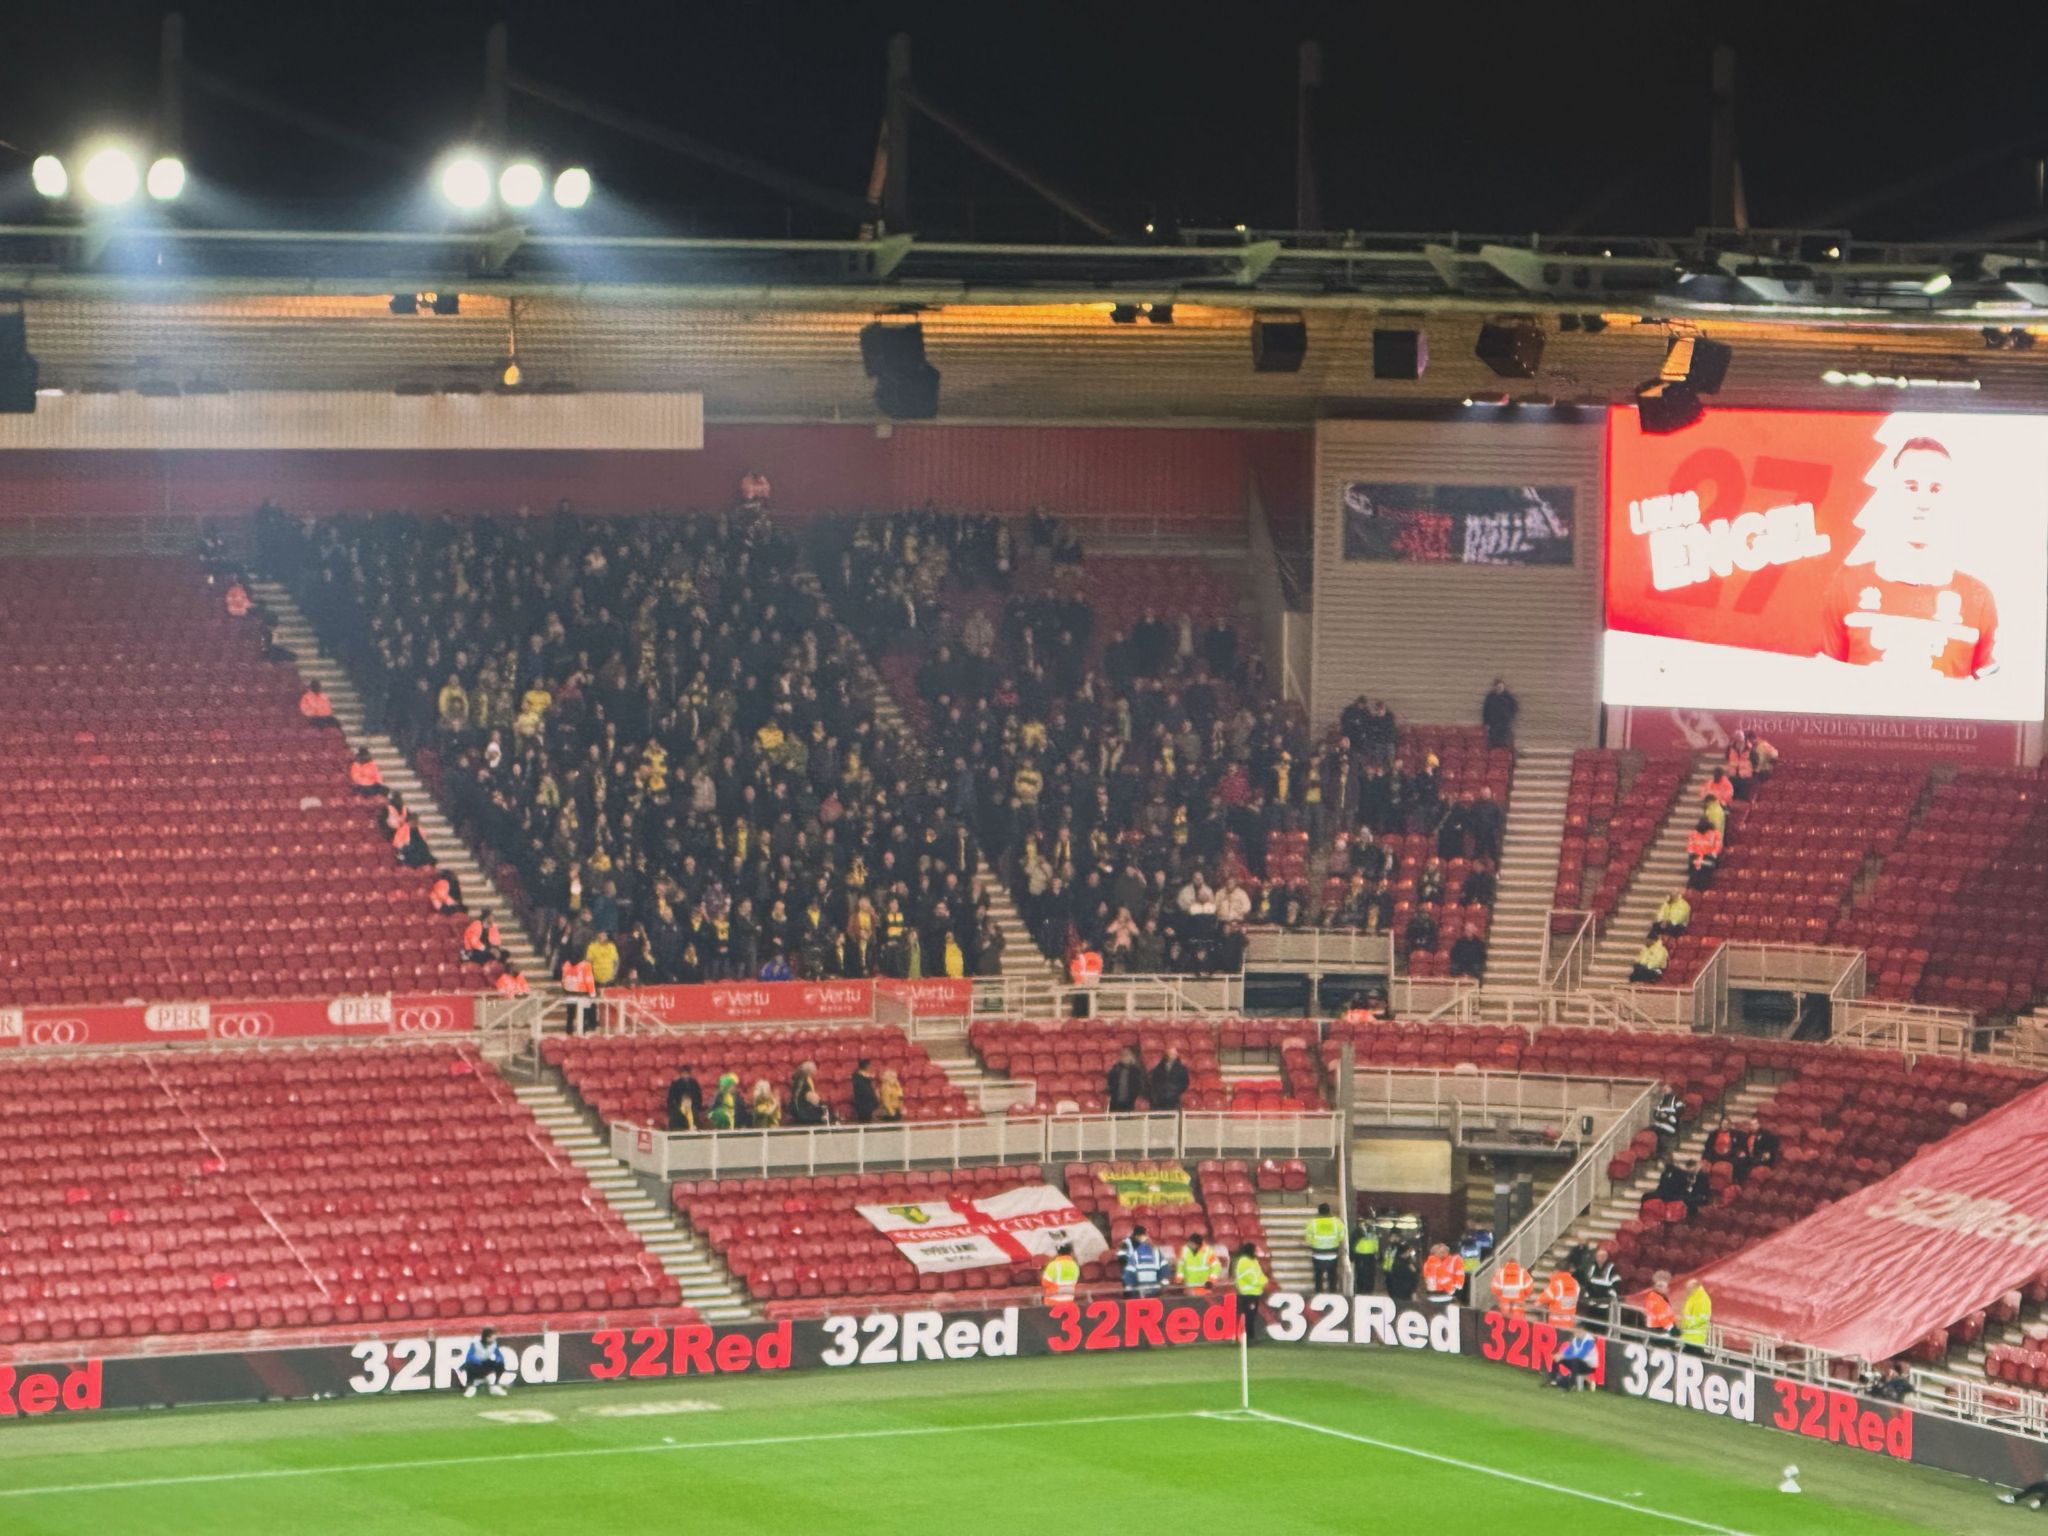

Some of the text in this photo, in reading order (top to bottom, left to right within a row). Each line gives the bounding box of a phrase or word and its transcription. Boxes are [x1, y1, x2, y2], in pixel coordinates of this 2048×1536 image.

[1803, 719, 1912, 738] INDUSTRIAL
[1916, 723, 1939, 739] UK
[1943, 724, 1978, 740] LTD
[157, 1007, 201, 1027] PER
[339, 1001, 384, 1021] PER
[728, 991, 770, 1006] Vertu
[820, 987, 861, 1003] Vertu
[911, 984, 954, 1000] Vertu
[590, 1319, 792, 1379] 32Red
[821, 1307, 1018, 1366] 32Red
[1047, 1293, 1237, 1352] 32Red
[1266, 1292, 1460, 1354] 32Red
[1482, 1311, 1605, 1385] 32R
[1623, 1342, 1755, 1422] 32Red
[1772, 1378, 1913, 1460] 32Red
